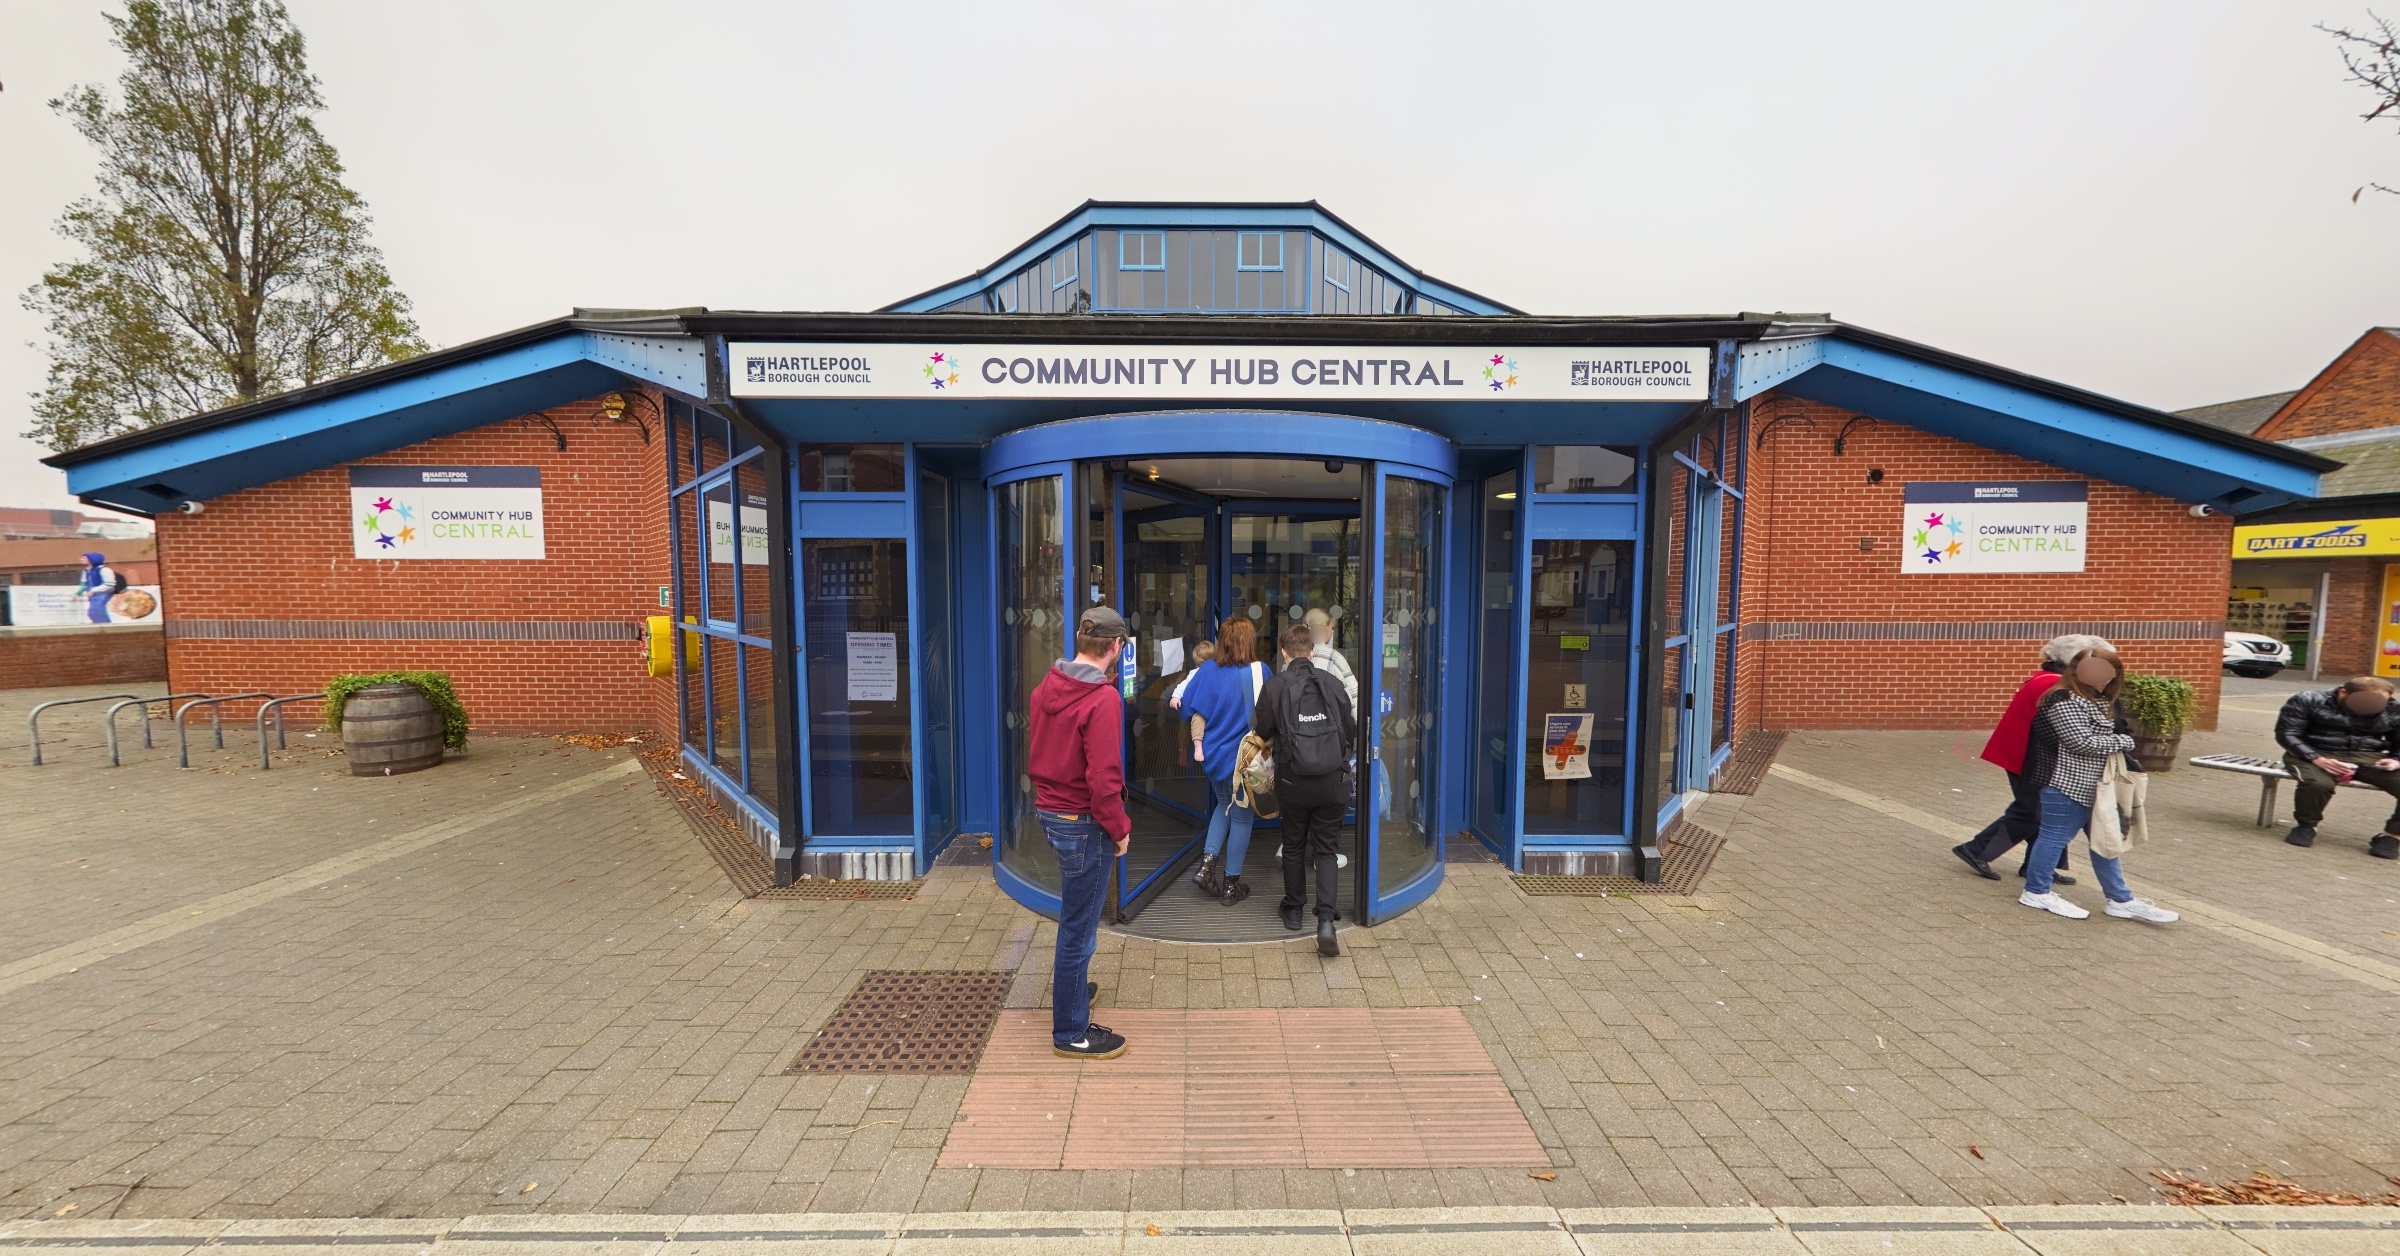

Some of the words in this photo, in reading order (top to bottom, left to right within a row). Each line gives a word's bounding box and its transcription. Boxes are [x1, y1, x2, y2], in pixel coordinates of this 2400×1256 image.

[767, 357, 871, 371] HARTLEPOOL
[1591, 360, 1692, 374] HARTLEPOOL
[768, 373, 820, 383] BOROUGH
[824, 373, 872, 383] COUNCIL
[981, 357, 1197, 385] COMMUNITY
[1210, 358, 1279, 385] HUB
[1291, 358, 1464, 386] CENTRAL
[1591, 376, 1642, 386] BOROUGH
[1645, 376, 1692, 386] COUNCIL
[431, 511, 504, 520] COMMUNITY
[509, 511, 533, 520] HUB
[432, 523, 534, 538] CENTRAL
[1979, 525, 2050, 535] COMMUNITY
[2053, 524, 2077, 534] HUB
[1978, 537, 2076, 553] CENTRAL
[2249, 537, 2299, 550] DART
[2300, 534, 2364, 548] FOODS
